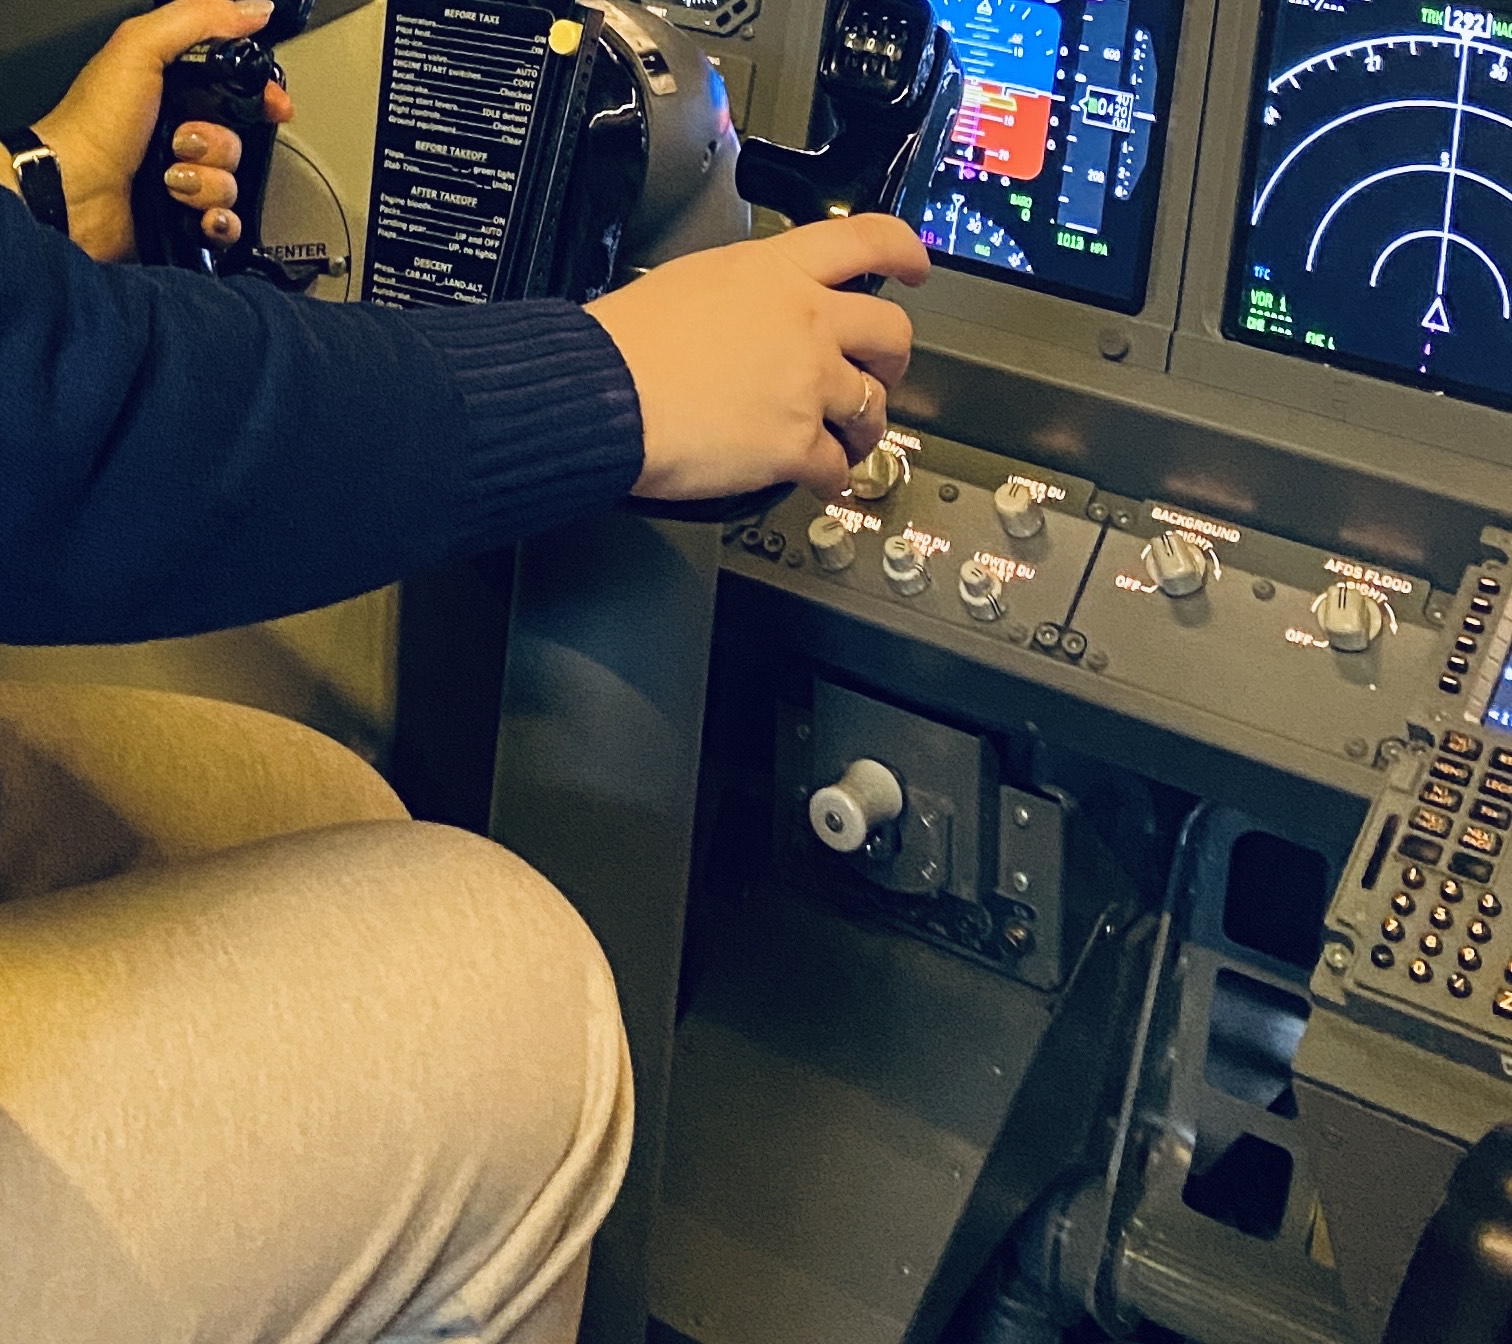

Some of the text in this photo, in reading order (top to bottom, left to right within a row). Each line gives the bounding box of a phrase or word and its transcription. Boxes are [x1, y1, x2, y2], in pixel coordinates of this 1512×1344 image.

[444, 9, 500, 25] BEFORE TAXI
[1421, 8, 1444, 25] TRK
[1453, 10, 1485, 30] 292
[423, 62, 447, 74] START
[513, 78, 535, 89] CONT
[415, 140, 488, 162] BEFORE TAKEOFF
[410, 185, 478, 208] AFTER TAKEOFF
[481, 225, 502, 236] AUTO
[1057, 231, 1085, 250] 1013
[413, 256, 453, 273] DESCENT
[1253, 265, 1271, 280] TFC
[1250, 289, 1286, 312] VOR 1
[886, 430, 921, 451] PANEL
[862, 513, 881, 531] DU
[1152, 508, 1240, 543] BACKGROUND
[973, 552, 1036, 580] LOWER DU
[1115, 574, 1141, 592] OFF
[1324, 559, 1412, 594] AFDS FLOOD
[1285, 629, 1313, 646] OFF
